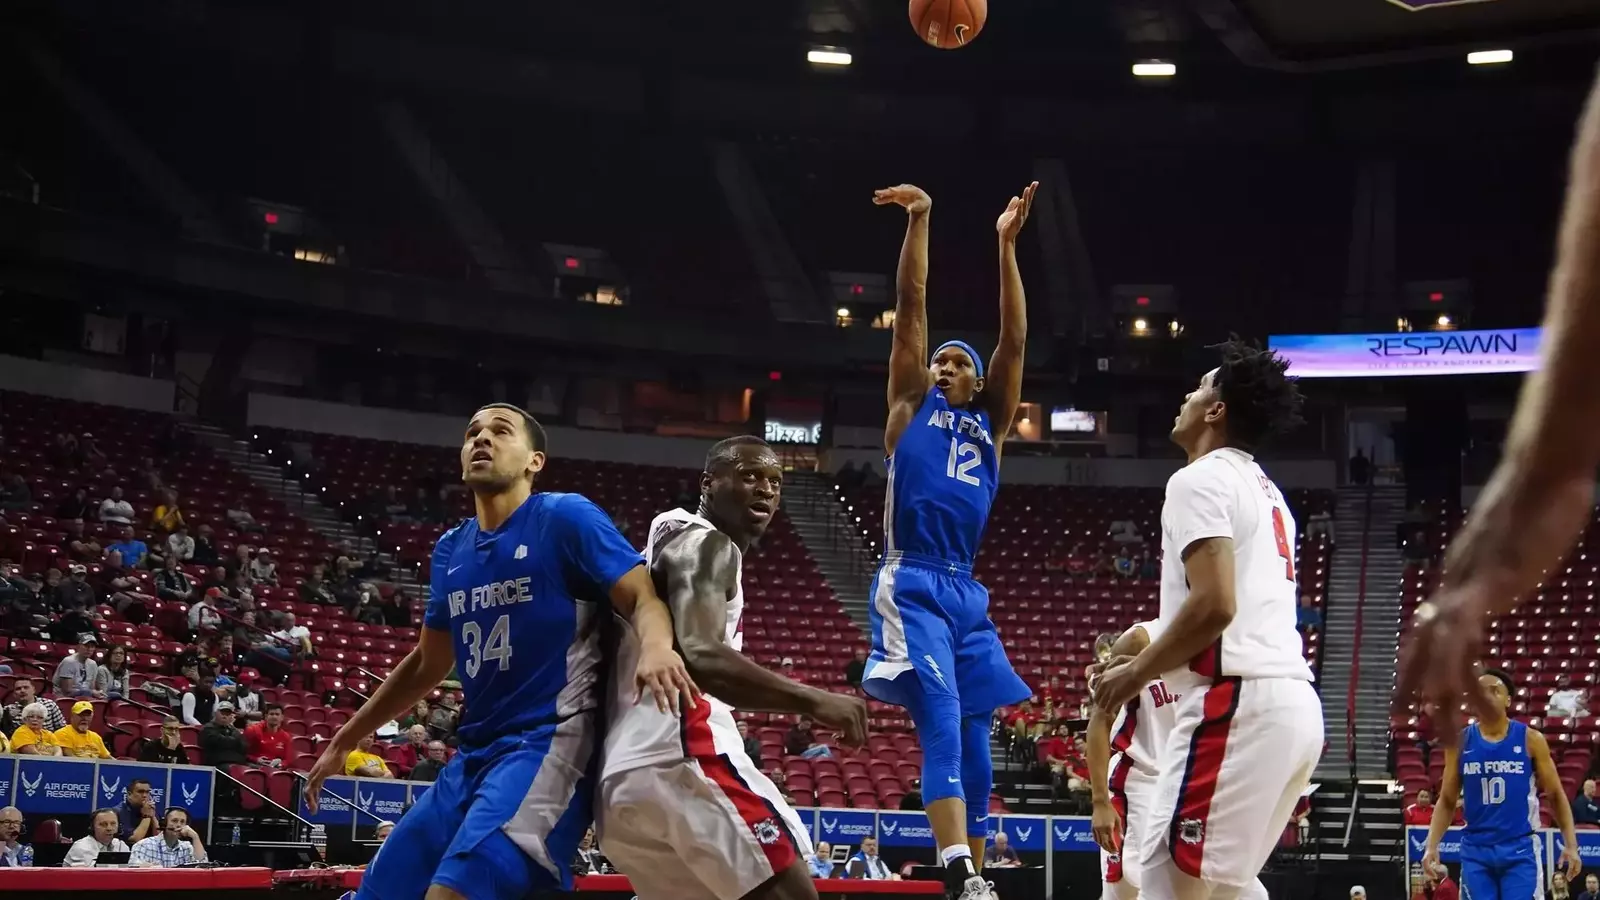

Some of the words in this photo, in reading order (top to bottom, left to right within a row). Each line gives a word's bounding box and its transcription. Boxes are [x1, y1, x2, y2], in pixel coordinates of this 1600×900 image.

[1366, 333, 1517, 357] RESPAWN
[927, 409, 955, 430] AIR
[765, 421, 809, 443] Pizza
[947, 437, 982, 487] 12
[471, 577, 533, 612] FORCE
[462, 614, 512, 679] 34
[1463, 762, 1481, 775] AIR
[1484, 761, 1525, 775] FORCE
[46, 790, 87, 799] RESERVE
[61, 784, 91, 792] FORCE
[1481, 776, 1506, 806] 10
